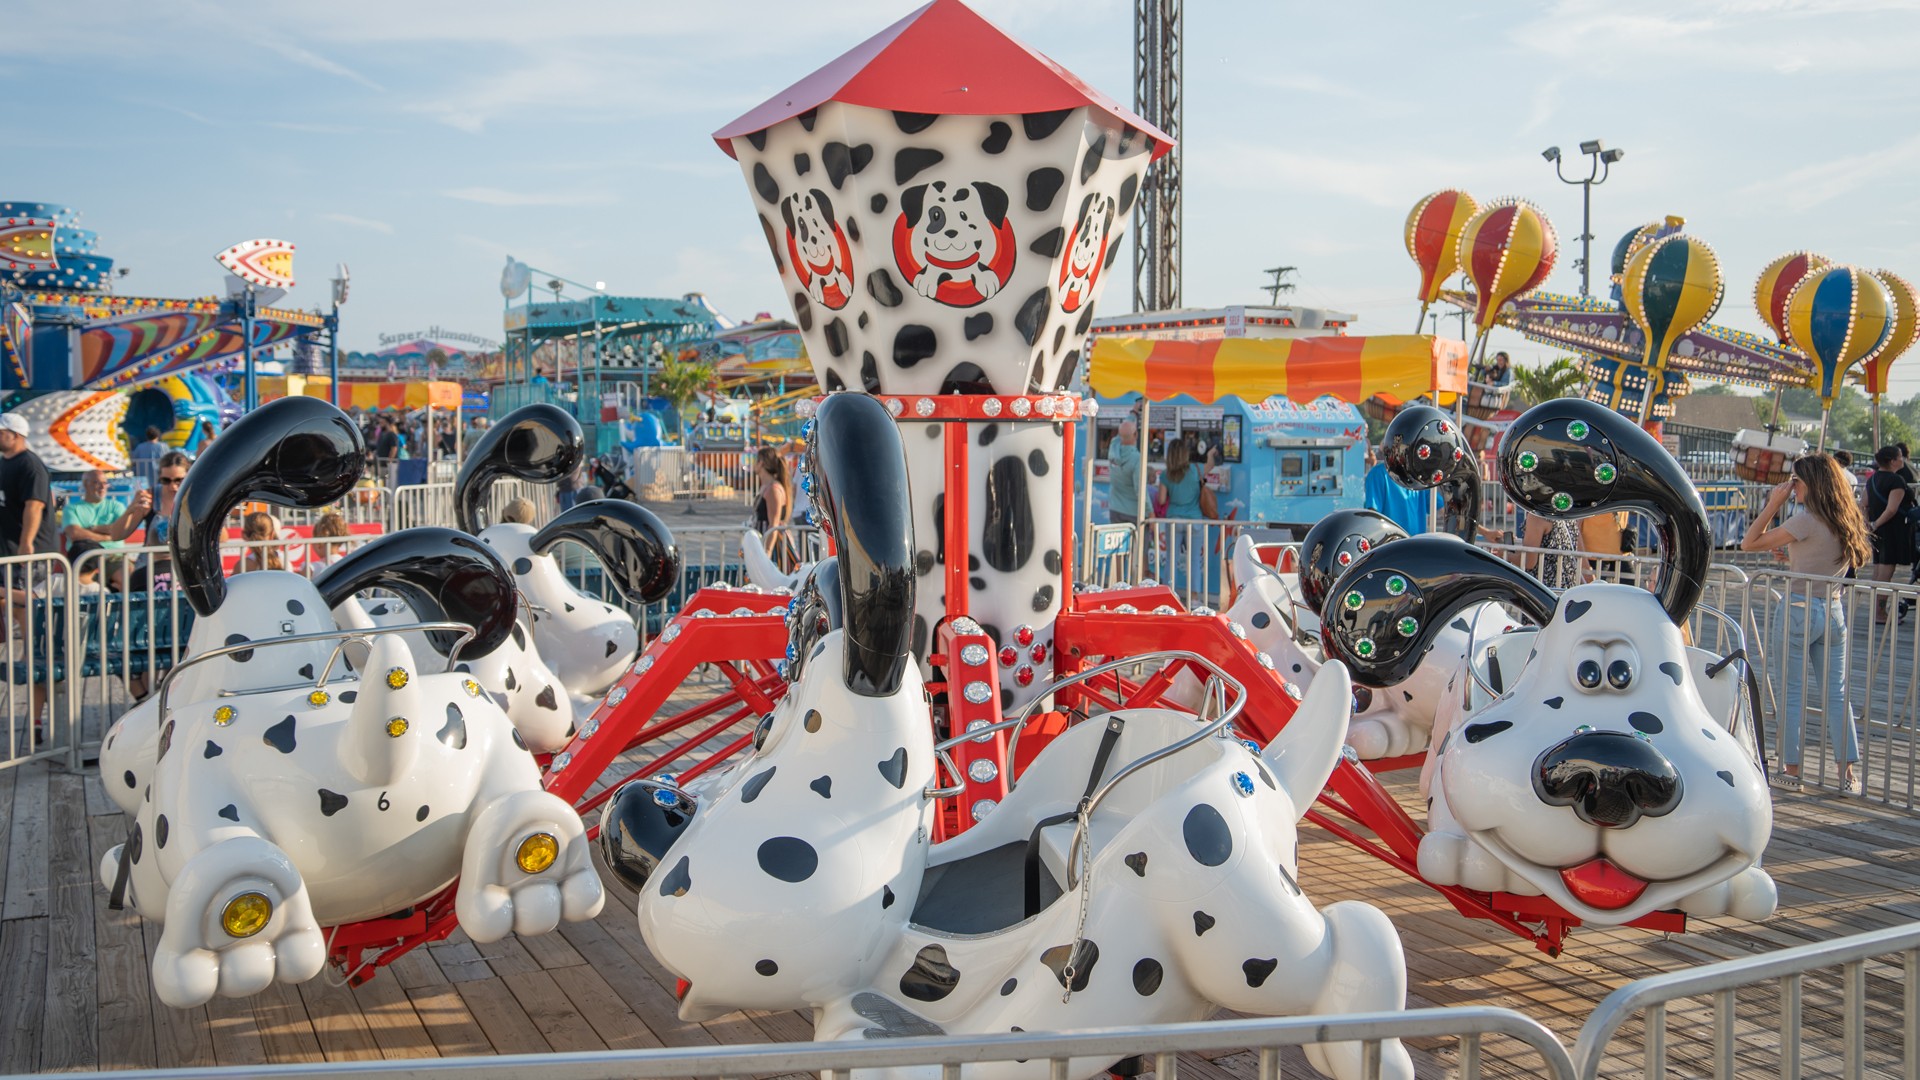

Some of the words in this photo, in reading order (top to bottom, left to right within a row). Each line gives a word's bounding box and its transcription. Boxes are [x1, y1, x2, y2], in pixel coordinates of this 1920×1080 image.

[1229, 315, 1240, 325] SELF
[378, 331, 423, 346] Super
[429, 325, 498, 349] Himalaya
[1104, 532, 1125, 550] EXIT
[377, 791, 390, 811] 6
